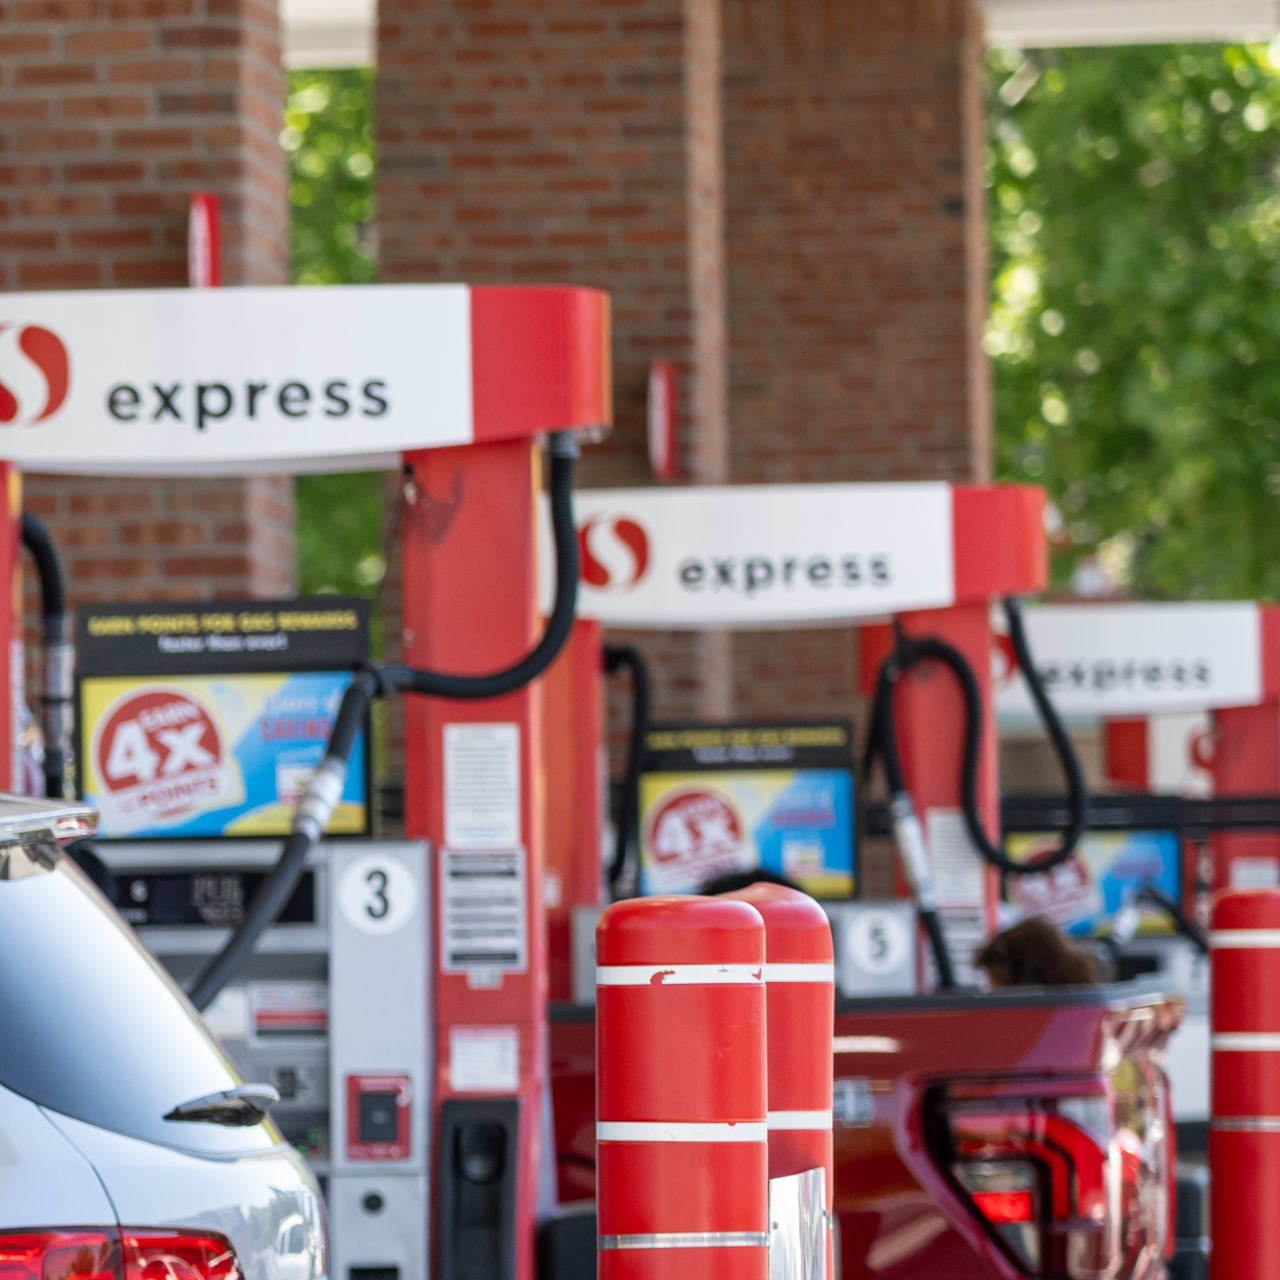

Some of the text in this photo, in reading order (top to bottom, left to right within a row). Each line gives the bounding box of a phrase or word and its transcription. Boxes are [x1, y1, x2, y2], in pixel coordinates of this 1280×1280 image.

[108, 378, 391, 429] express
[679, 549, 893, 597] express
[1042, 660, 1211, 696] express
[365, 870, 389, 918] 3
[868, 921, 889, 957] 5
